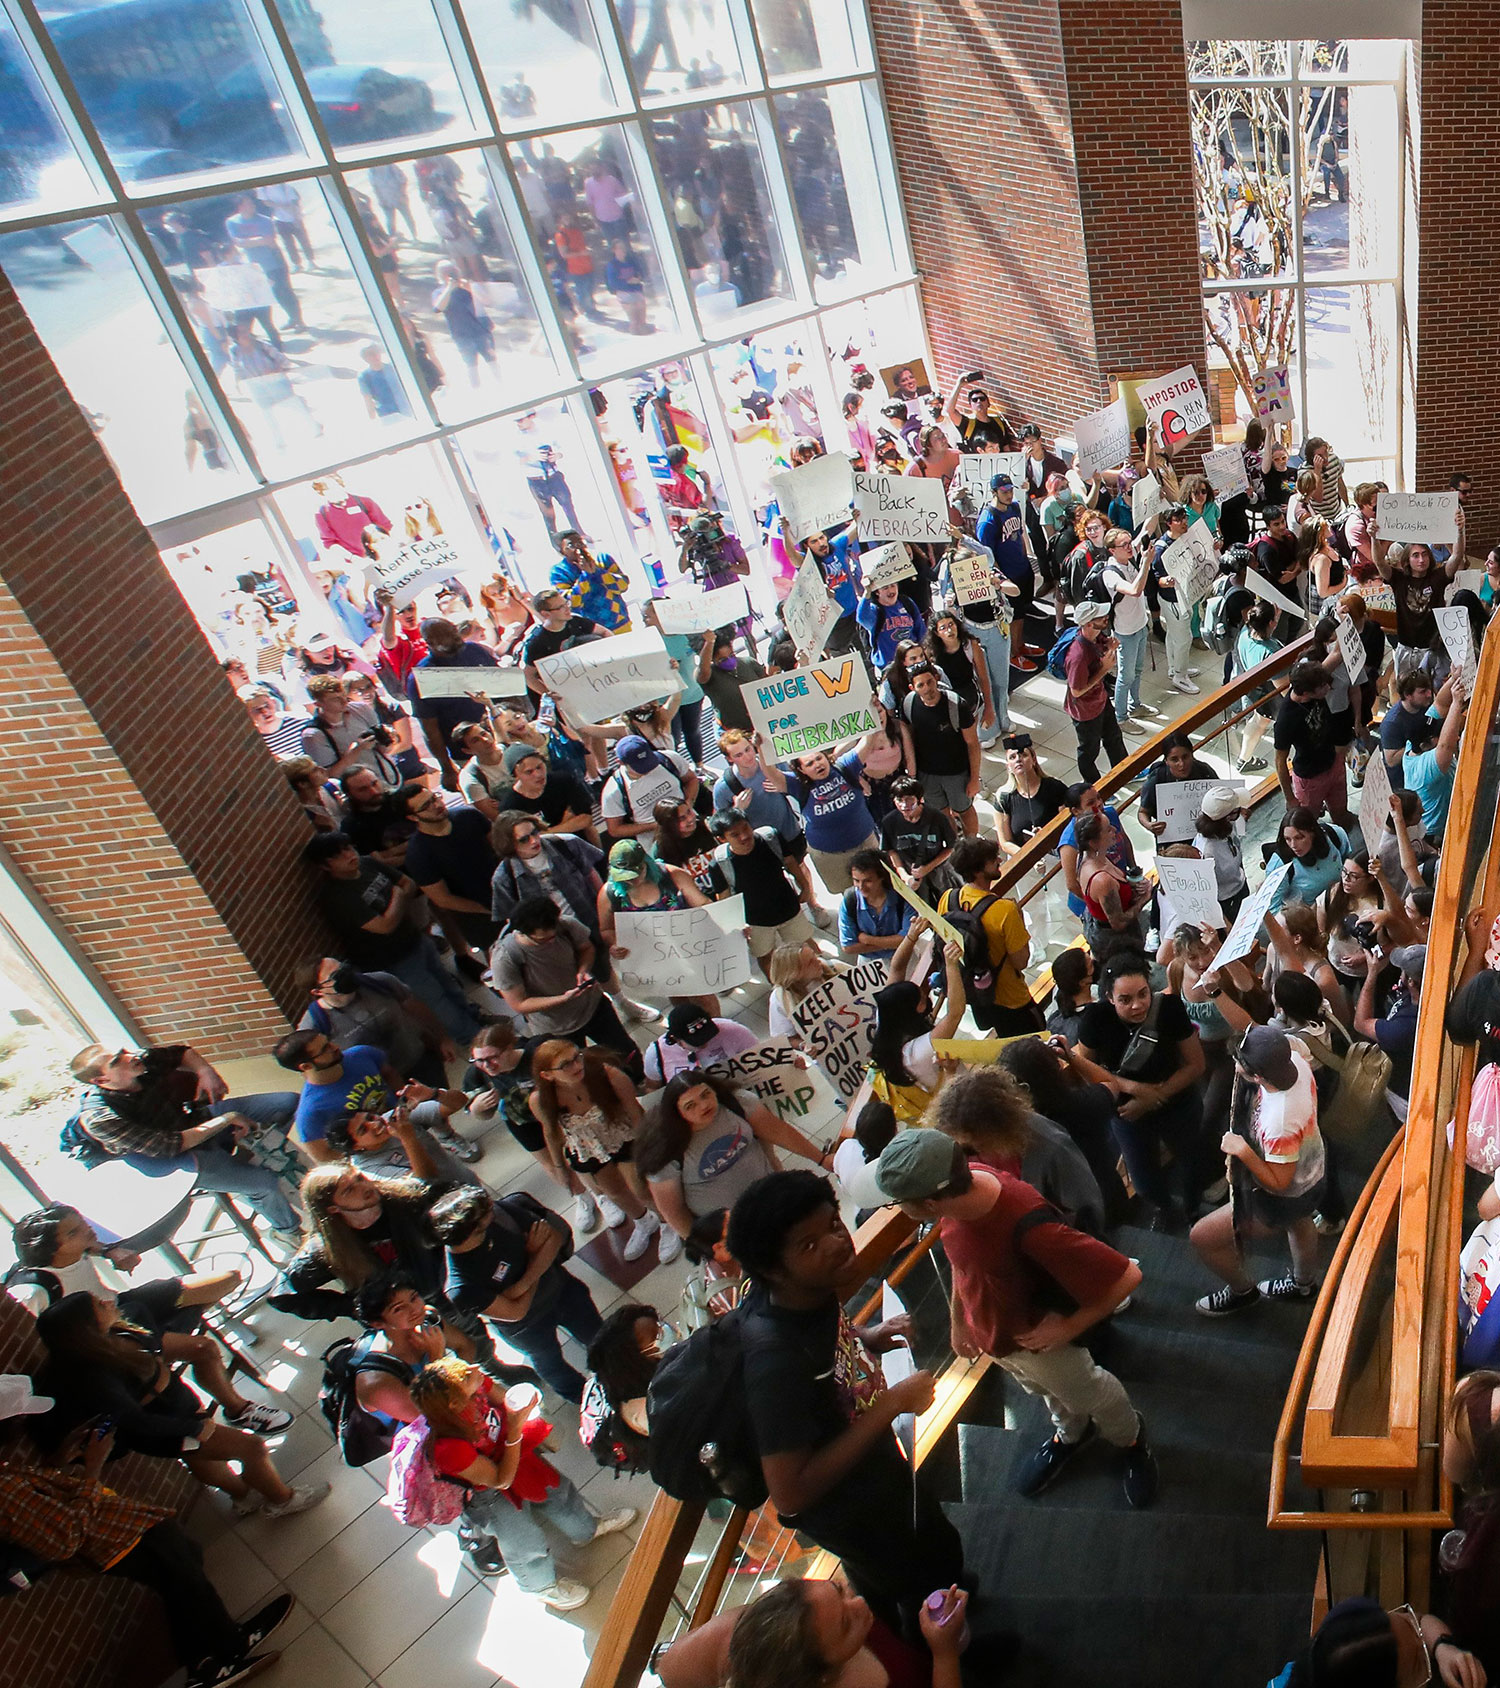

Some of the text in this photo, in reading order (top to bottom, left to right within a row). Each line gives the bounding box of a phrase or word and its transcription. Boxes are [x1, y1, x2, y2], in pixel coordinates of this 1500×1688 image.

[1144, 378, 1198, 410] IMPOSTOR
[1254, 369, 1288, 395] SAY
[1183, 398, 1204, 417] BEN
[1189, 413, 1207, 430] SUS
[963, 455, 1024, 482] FUCK
[855, 473, 891, 495] Run
[878, 494, 939, 520] Back to
[1407, 494, 1434, 509] Back
[858, 518, 949, 538] NEBRASKA
[1383, 518, 1429, 532] Nebraska
[374, 539, 449, 577] Kent Fuchs
[972, 560, 980, 572] B
[382, 550, 459, 595] Sasse Sucks
[970, 570, 988, 582] BEN
[967, 585, 992, 601] BIGOT
[1360, 587, 1386, 597] KEEP
[1442, 609, 1468, 632] GE
[588, 661, 643, 693] has a
[756, 659, 853, 710] HUGE W
[768, 713, 799, 734] FOR
[772, 708, 877, 758] NEBRASKA
[810, 775, 848, 800] FLORIDA
[1183, 781, 1213, 792] FUCHS
[813, 789, 856, 816] GATORS
[1165, 807, 1175, 817] UF
[632, 908, 709, 940] KEEP
[653, 937, 721, 963] SASSE
[1228, 921, 1255, 960] THE
[703, 954, 738, 987] UF
[792, 960, 890, 1035] KEEP YOUR
[704, 1047, 795, 1080] SASSE
[825, 1031, 861, 1076] OUT
[746, 1075, 785, 1099] HE
[838, 1060, 868, 1098] OUR
[344, 1074, 383, 1111] ONDAY
[703, 1141, 747, 1177] NASA
